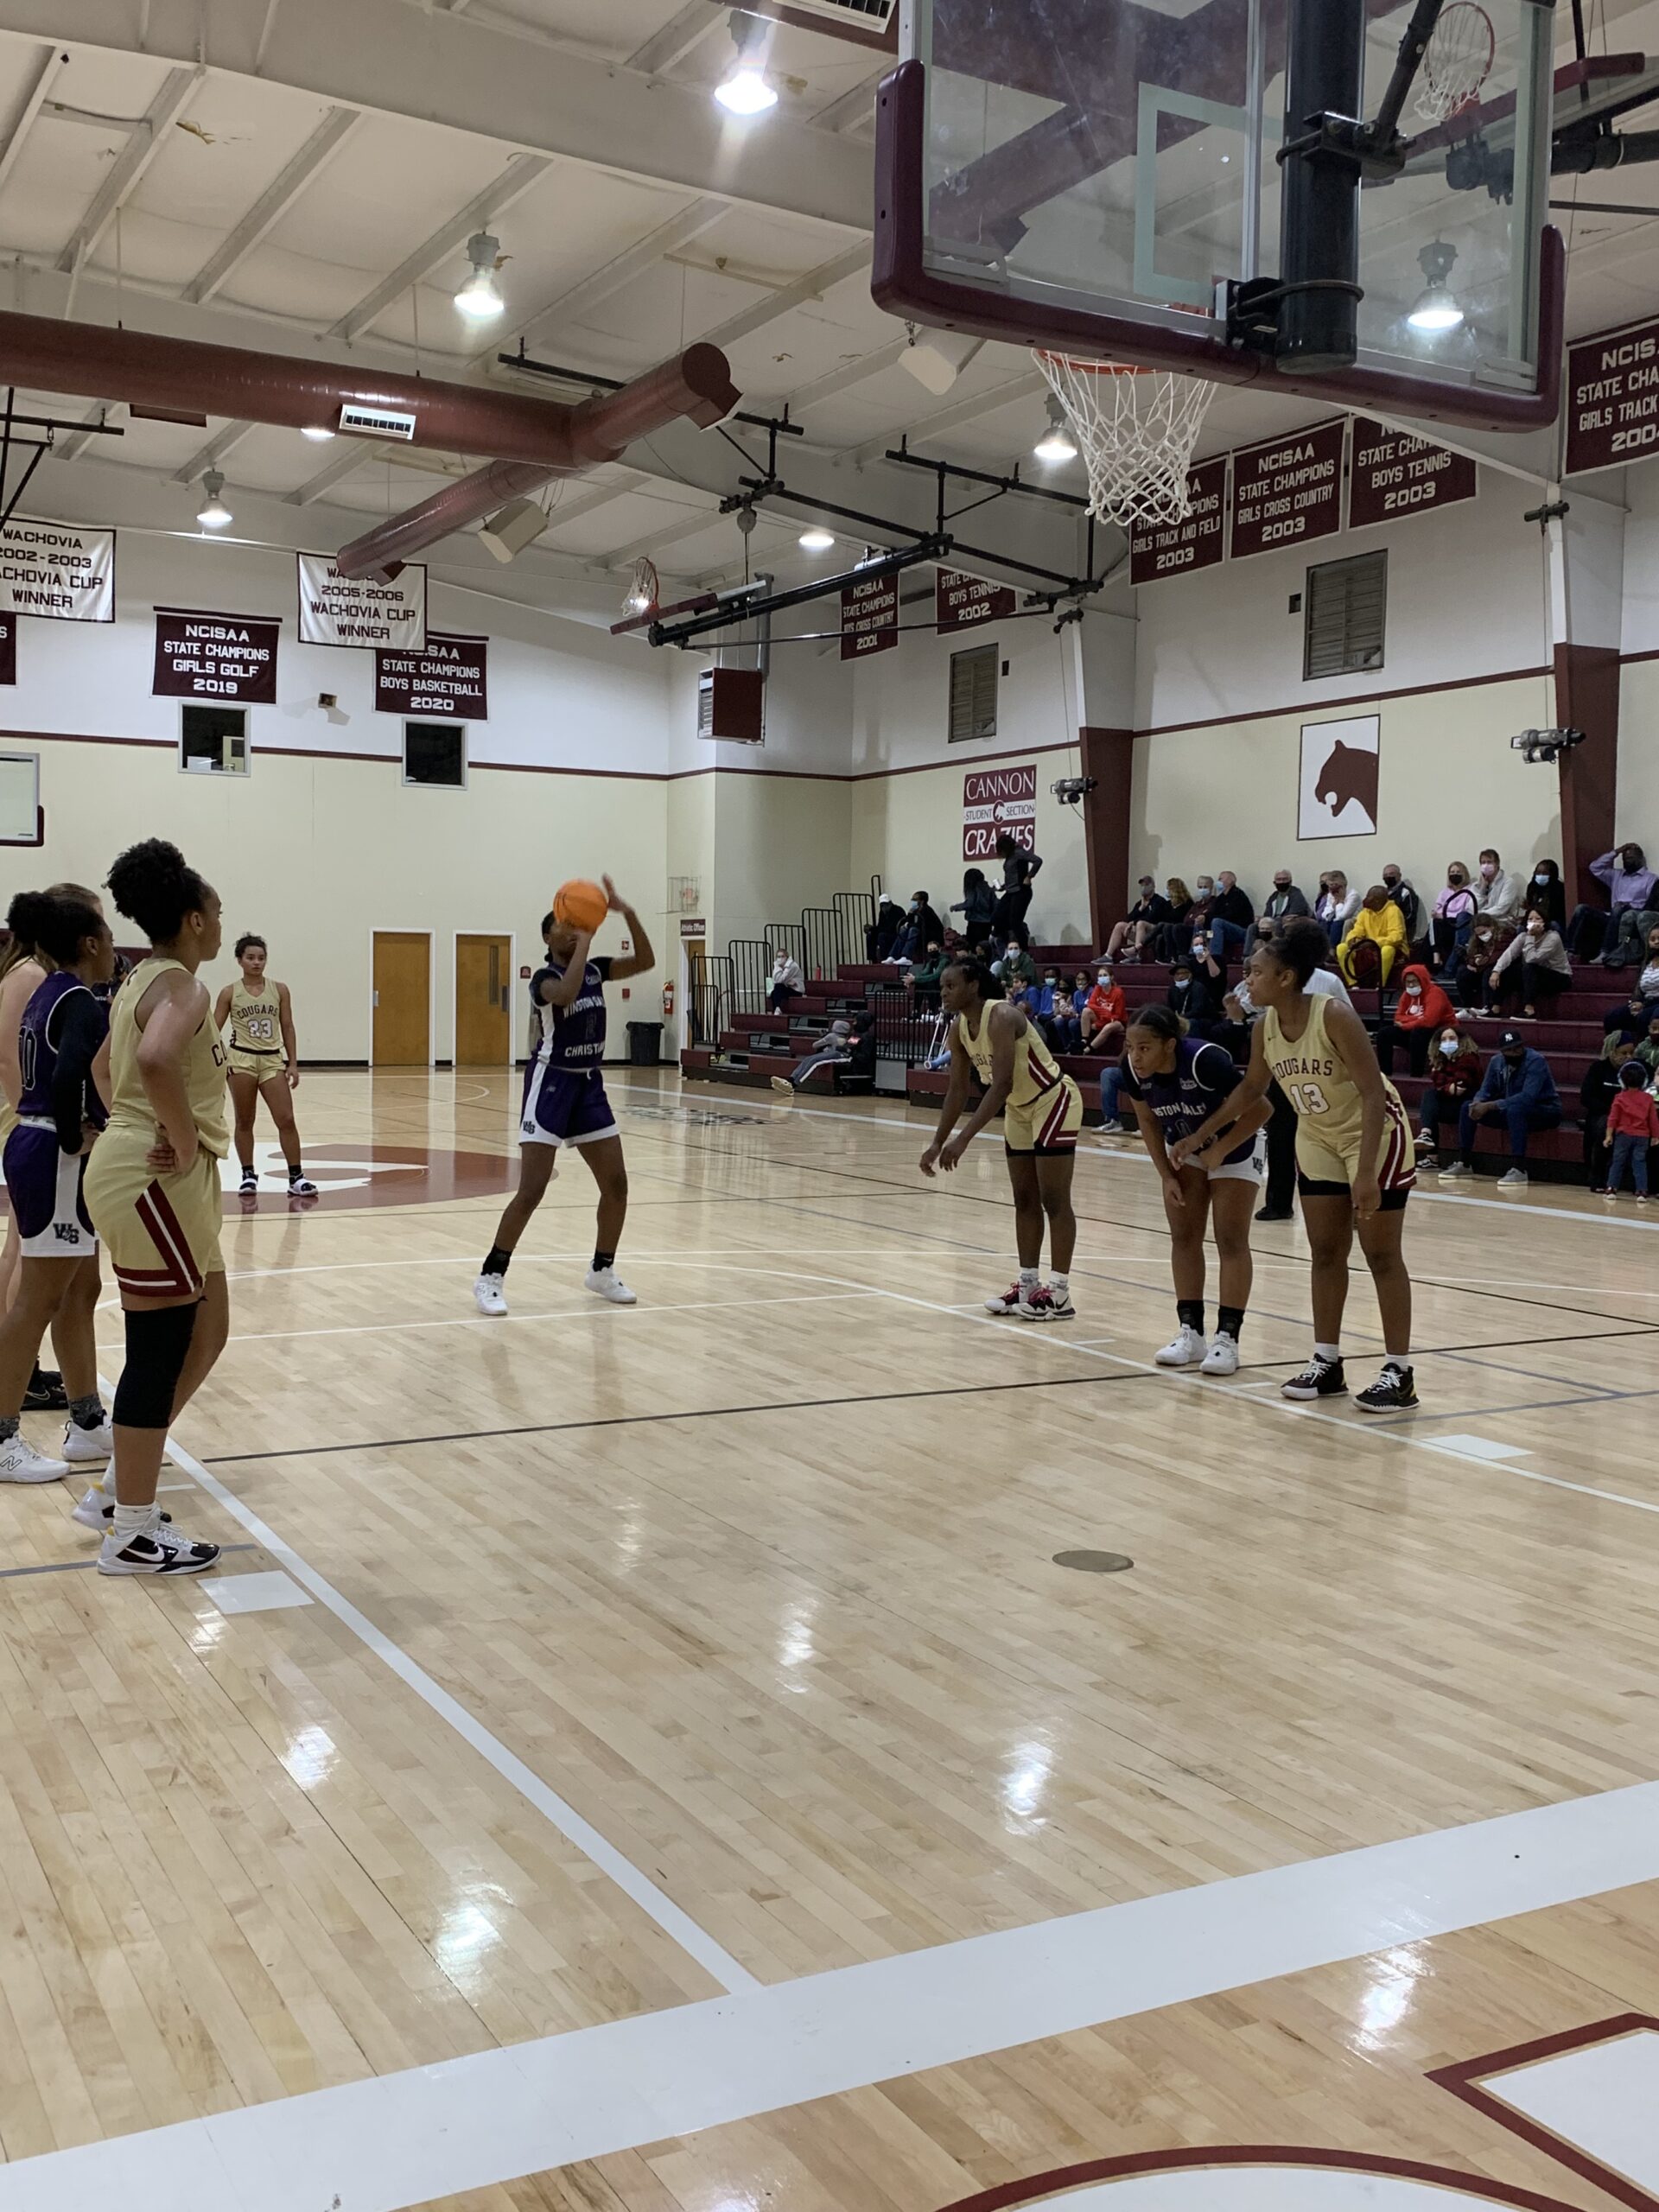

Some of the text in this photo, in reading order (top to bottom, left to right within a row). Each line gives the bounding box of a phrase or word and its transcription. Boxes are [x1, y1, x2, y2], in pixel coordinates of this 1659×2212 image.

[1601, 338, 1659, 371] NCIS
[1576, 376, 1623, 405] STATE
[1579, 394, 1659, 432] GIRLS TRACK
[1611, 423, 1659, 453] 200
[1258, 442, 1315, 474] NCISAA
[1357, 442, 1395, 467] STATE
[1238, 459, 1335, 501] STATE CHAMPIONS
[1371, 450, 1452, 489] BOYS TENNIS
[1237, 482, 1334, 525] GIRLS CROSS COUNTRY
[1384, 481, 1436, 511] 2003
[3, 528, 83, 550] WACHOVIA
[1132, 515, 1220, 554] GIRLS TRACK AND FIELD
[1262, 516, 1306, 543] 2003
[0, 547, 92, 569] 002-2003
[1156, 546, 1194, 570] 2003
[0, 567, 103, 590] CHOVIA CUP
[852, 578, 884, 600] NCISAA
[941, 572, 962, 589] STATE
[12, 588, 73, 608] WINNER
[321, 585, 404, 601] 2005-2006
[949, 588, 968, 607] BOYS
[310, 601, 416, 621] WACHOVIA CUP
[842, 592, 895, 619] STATE CHAMPIONS
[957, 601, 992, 621] 2002
[336, 623, 390, 640] WINNER
[855, 619, 871, 632] CROSS
[872, 610, 895, 629] COUNTRY
[185, 624, 250, 643] NCISAA
[856, 632, 878, 651] 2001
[163, 640, 270, 661] STATE CHAMPIONS
[172, 658, 259, 677] GIRLS GOLF
[382, 658, 480, 679] STATE CHAMPIONS
[193, 678, 238, 695] 2019
[379, 676, 484, 696] BOYS BASKETBALL
[410, 696, 455, 711] 2020
[966, 770, 1035, 800] CANNON
[237, 1004, 278, 1020] COUGARS
[1290, 1082, 1331, 1116] 13
